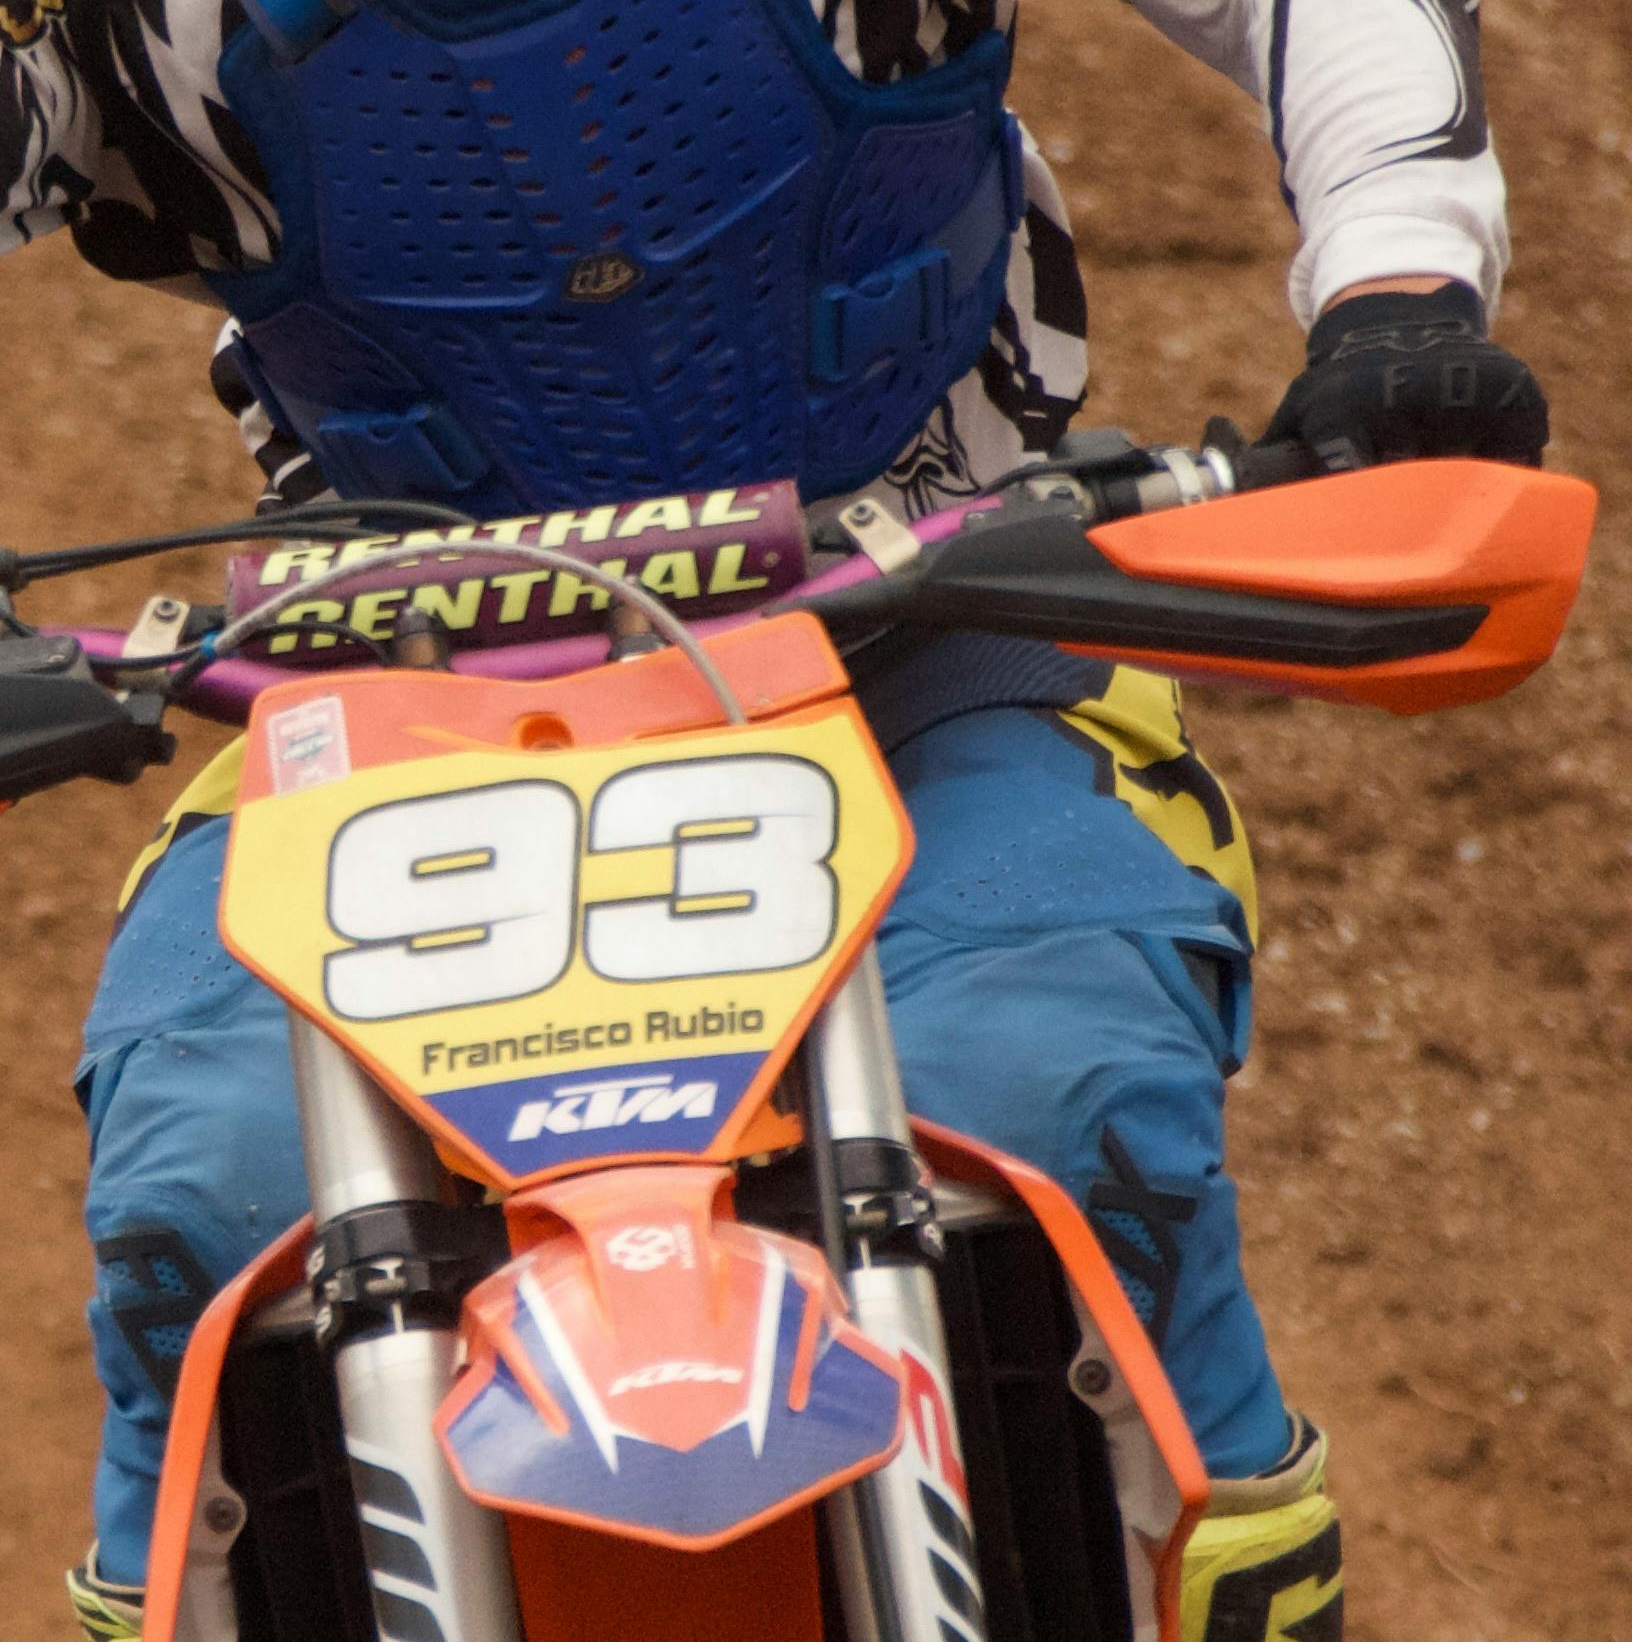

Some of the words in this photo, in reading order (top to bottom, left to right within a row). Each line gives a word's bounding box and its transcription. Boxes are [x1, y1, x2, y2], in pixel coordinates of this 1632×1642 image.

[323, 752, 840, 1022] 93
[421, 1022, 632, 1076] Francisco
[645, 1001, 765, 1043] Rubio
[507, 1074, 717, 1143] KTM
